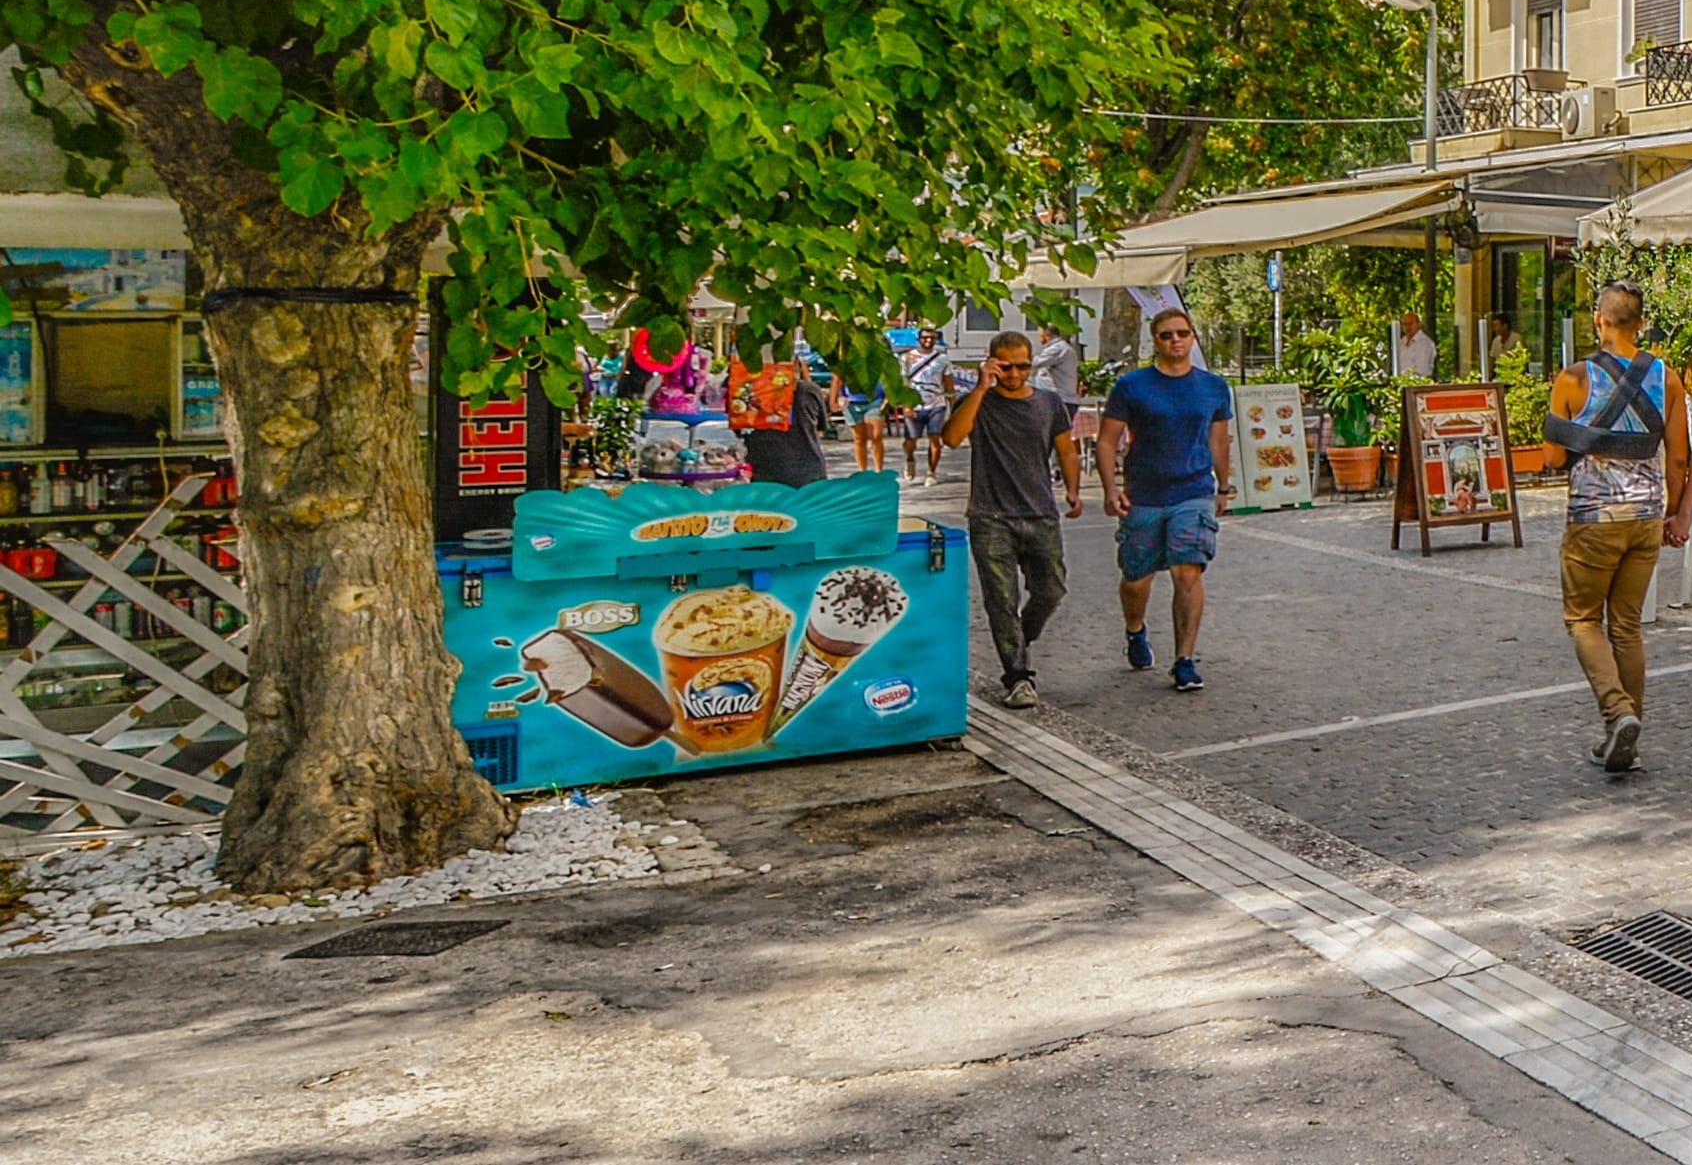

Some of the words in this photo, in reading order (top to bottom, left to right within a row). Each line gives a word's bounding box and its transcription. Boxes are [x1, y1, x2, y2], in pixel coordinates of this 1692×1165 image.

[459, 370, 527, 486] HEL
[565, 606, 634, 628] BOSS
[672, 679, 769, 720] Nirvana
